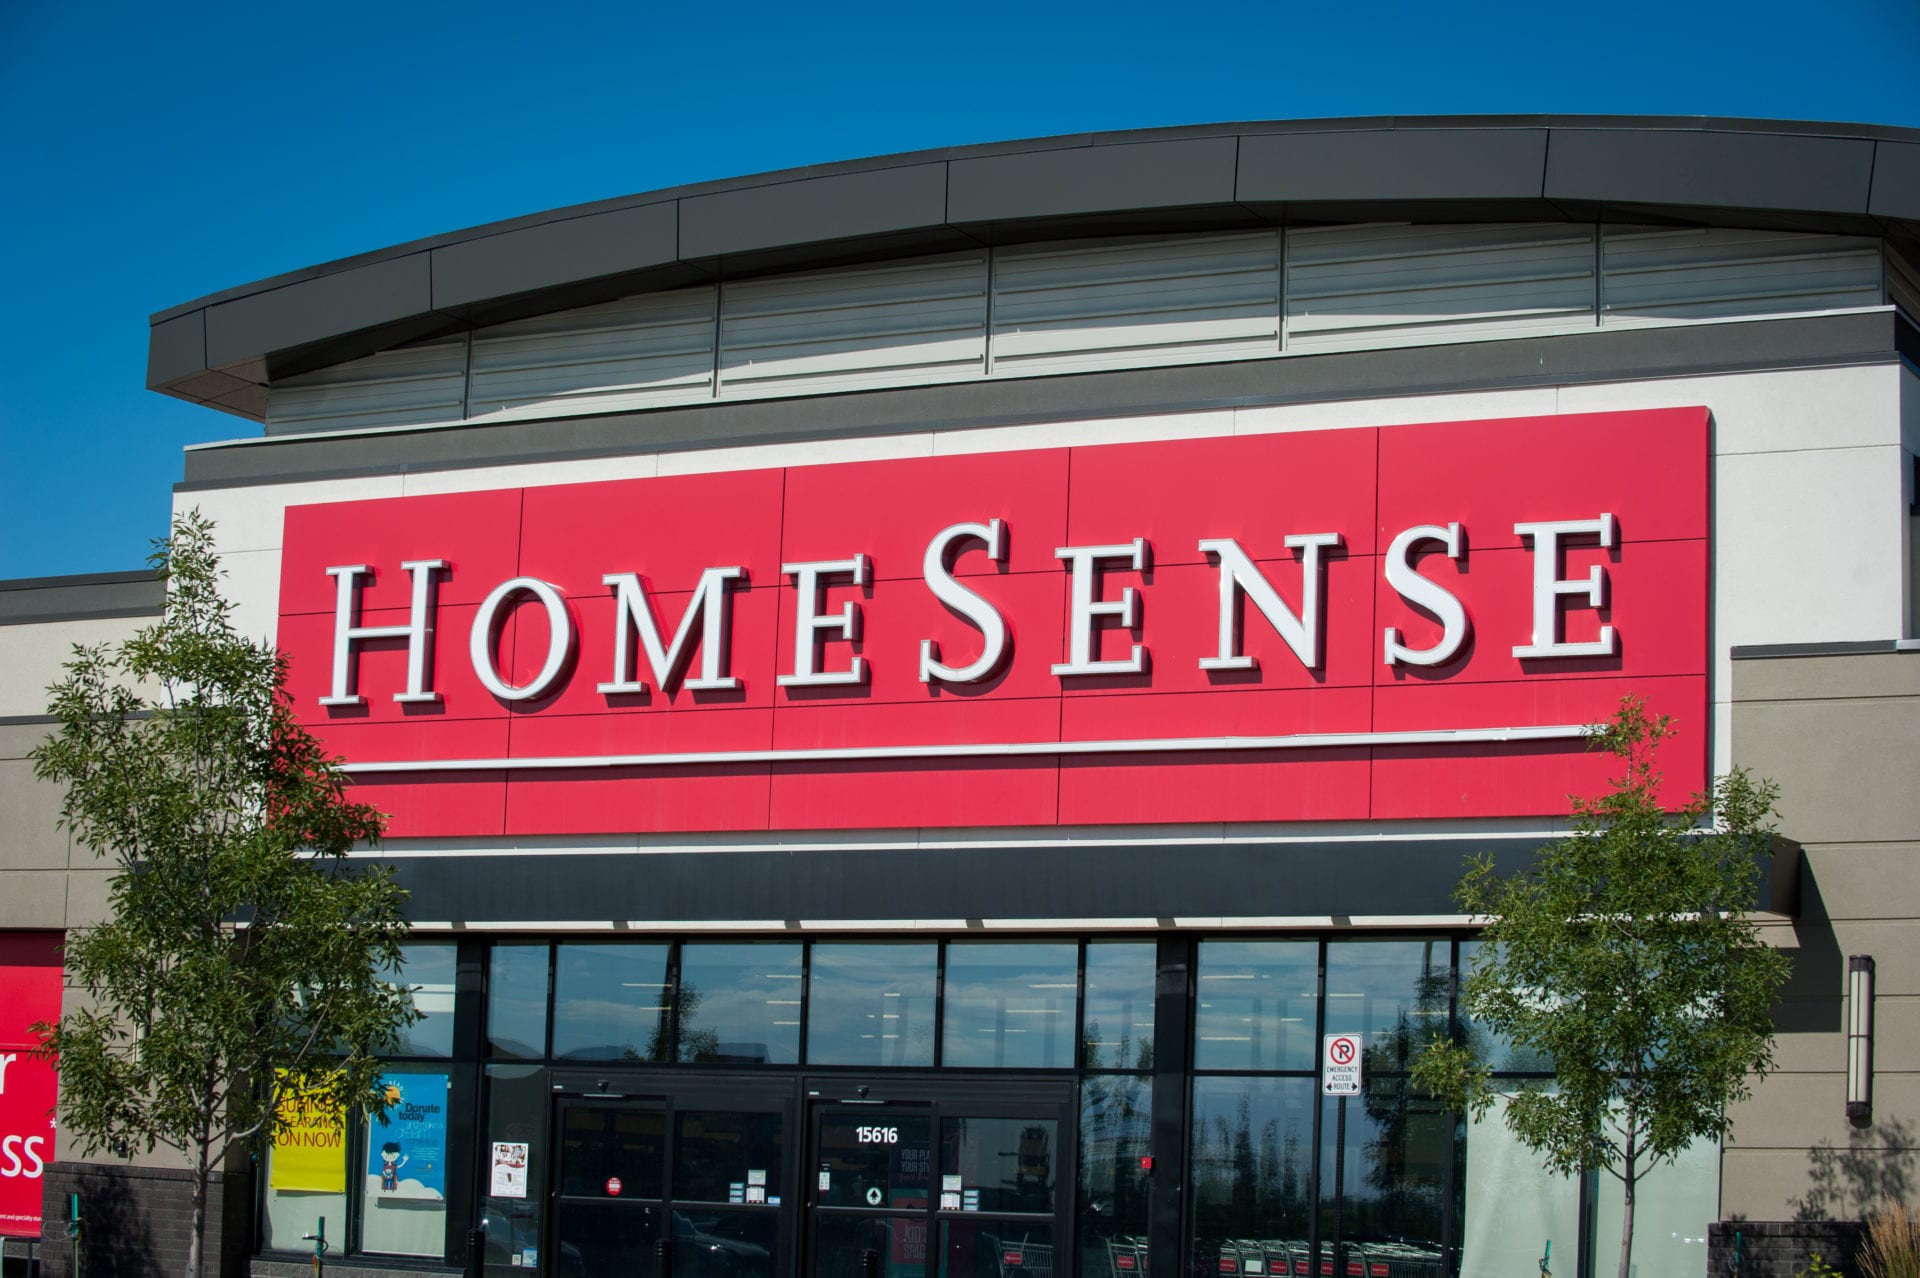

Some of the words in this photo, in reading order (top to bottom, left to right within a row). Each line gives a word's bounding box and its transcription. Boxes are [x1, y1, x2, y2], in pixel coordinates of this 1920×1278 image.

[1326, 1065, 1358, 1073] EMERGENCY
[1332, 1074, 1353, 1082] ACCESS
[1333, 1082, 1351, 1090] ROUTE
[405, 1102, 441, 1114] Donate
[398, 1111, 426, 1122] today
[277, 1131, 300, 1147] ON
[303, 1131, 341, 1148] NOW
[856, 1126, 898, 1144] 15616
